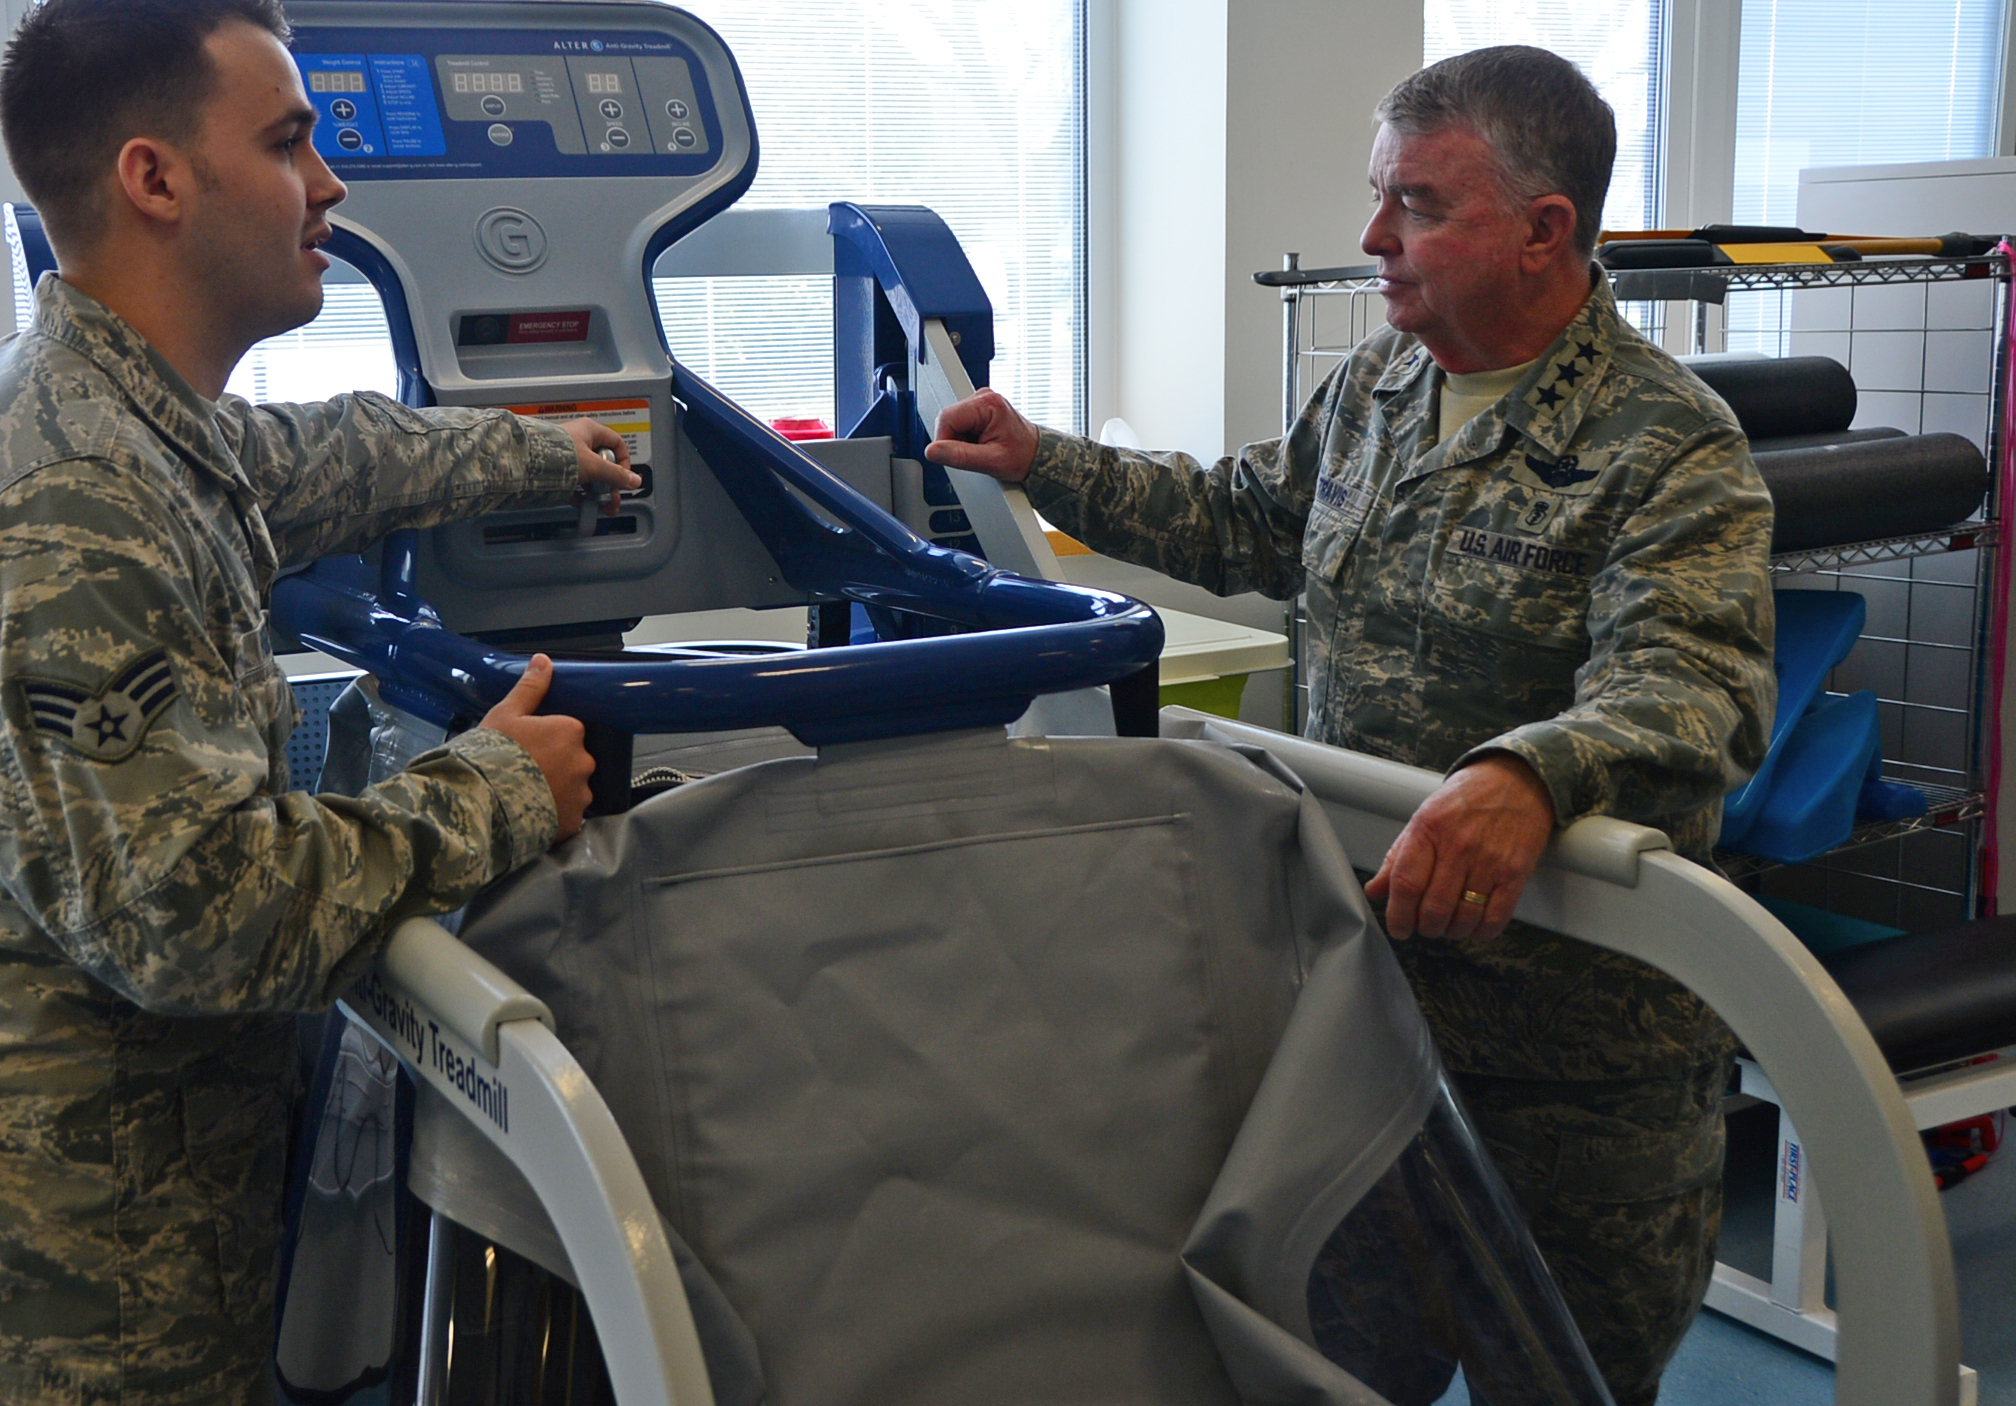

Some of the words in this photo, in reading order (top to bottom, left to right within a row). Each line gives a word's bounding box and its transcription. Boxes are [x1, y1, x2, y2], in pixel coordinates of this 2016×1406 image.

[545, 403, 577, 412] WARNING
[1459, 530, 1486, 557] U.S.
[1492, 537, 1521, 565] AIR
[1522, 543, 1591, 577] FORCE
[428, 1019, 509, 1134] Treadmill
